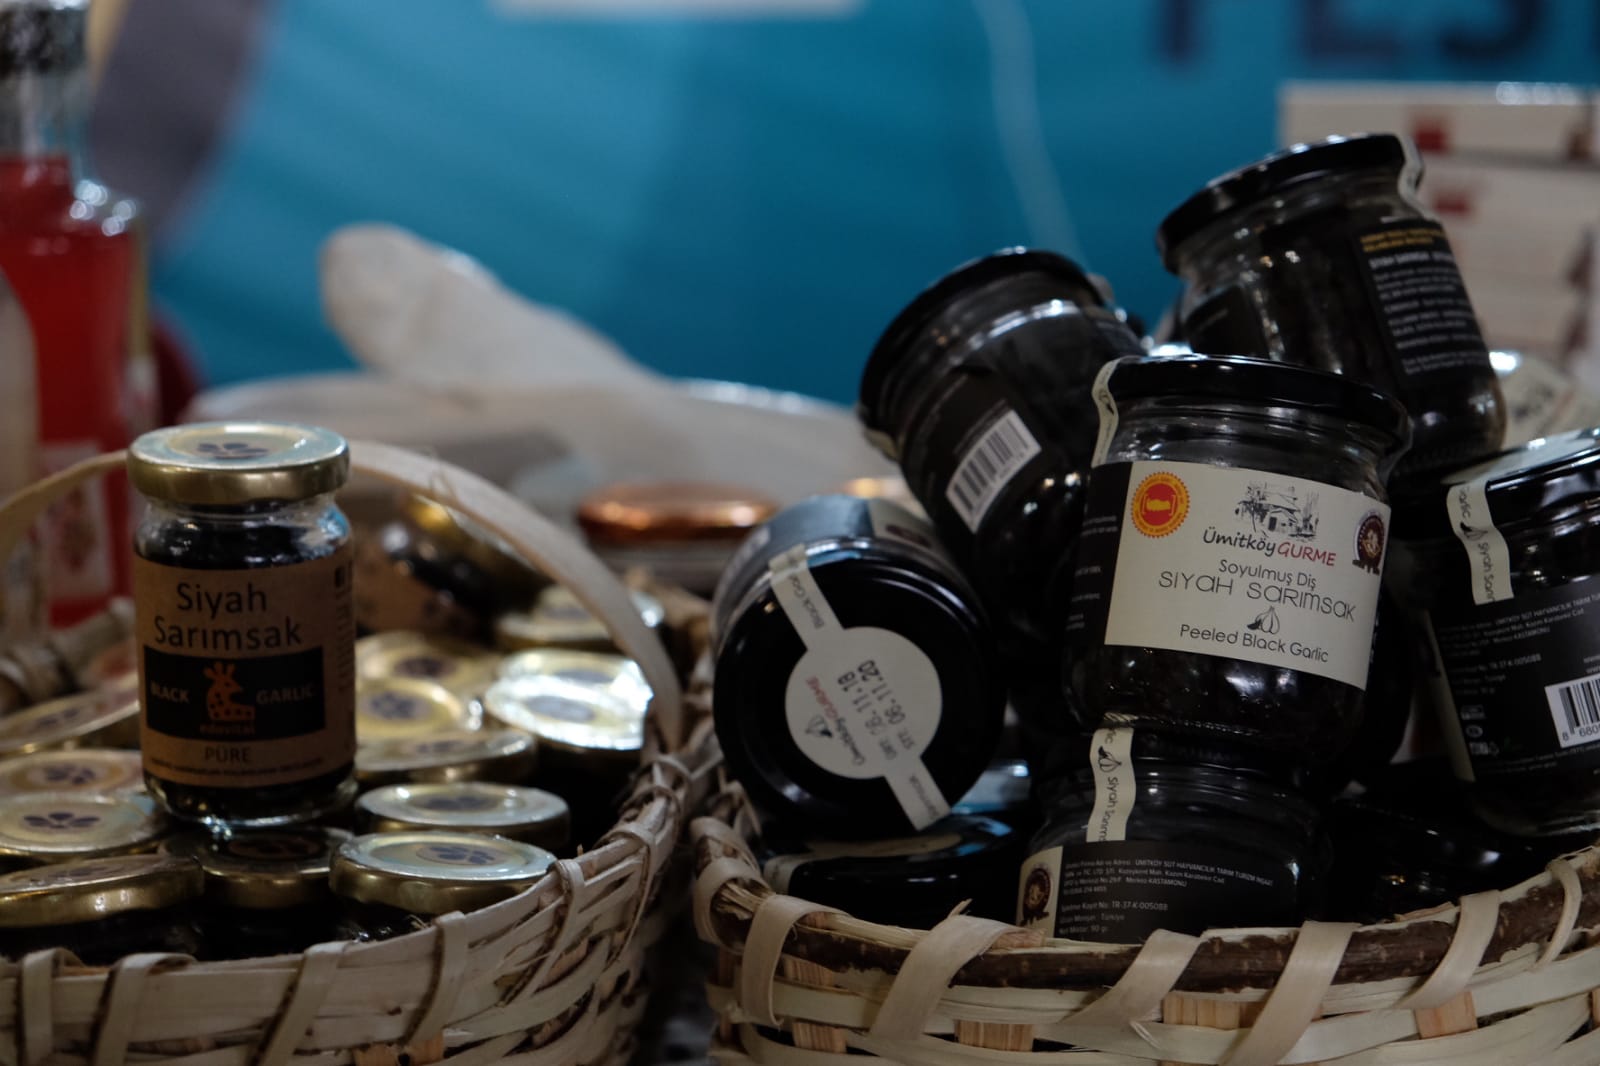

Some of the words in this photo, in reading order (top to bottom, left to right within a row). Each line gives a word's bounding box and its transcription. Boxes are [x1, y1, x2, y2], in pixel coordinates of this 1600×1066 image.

[1219, 559, 1293, 586] Soyulmuş
[1297, 572, 1317, 592] Diş
[177, 582, 267, 619] Siyah
[154, 615, 302, 651] Sarımsak
[1180, 624, 1239, 645] Peeled
[1242, 633, 1286, 653] Black
[1290, 642, 1329, 663] Garlic
[256, 682, 317, 705] GARLIC
[1579, 725, 1600, 737] 680
